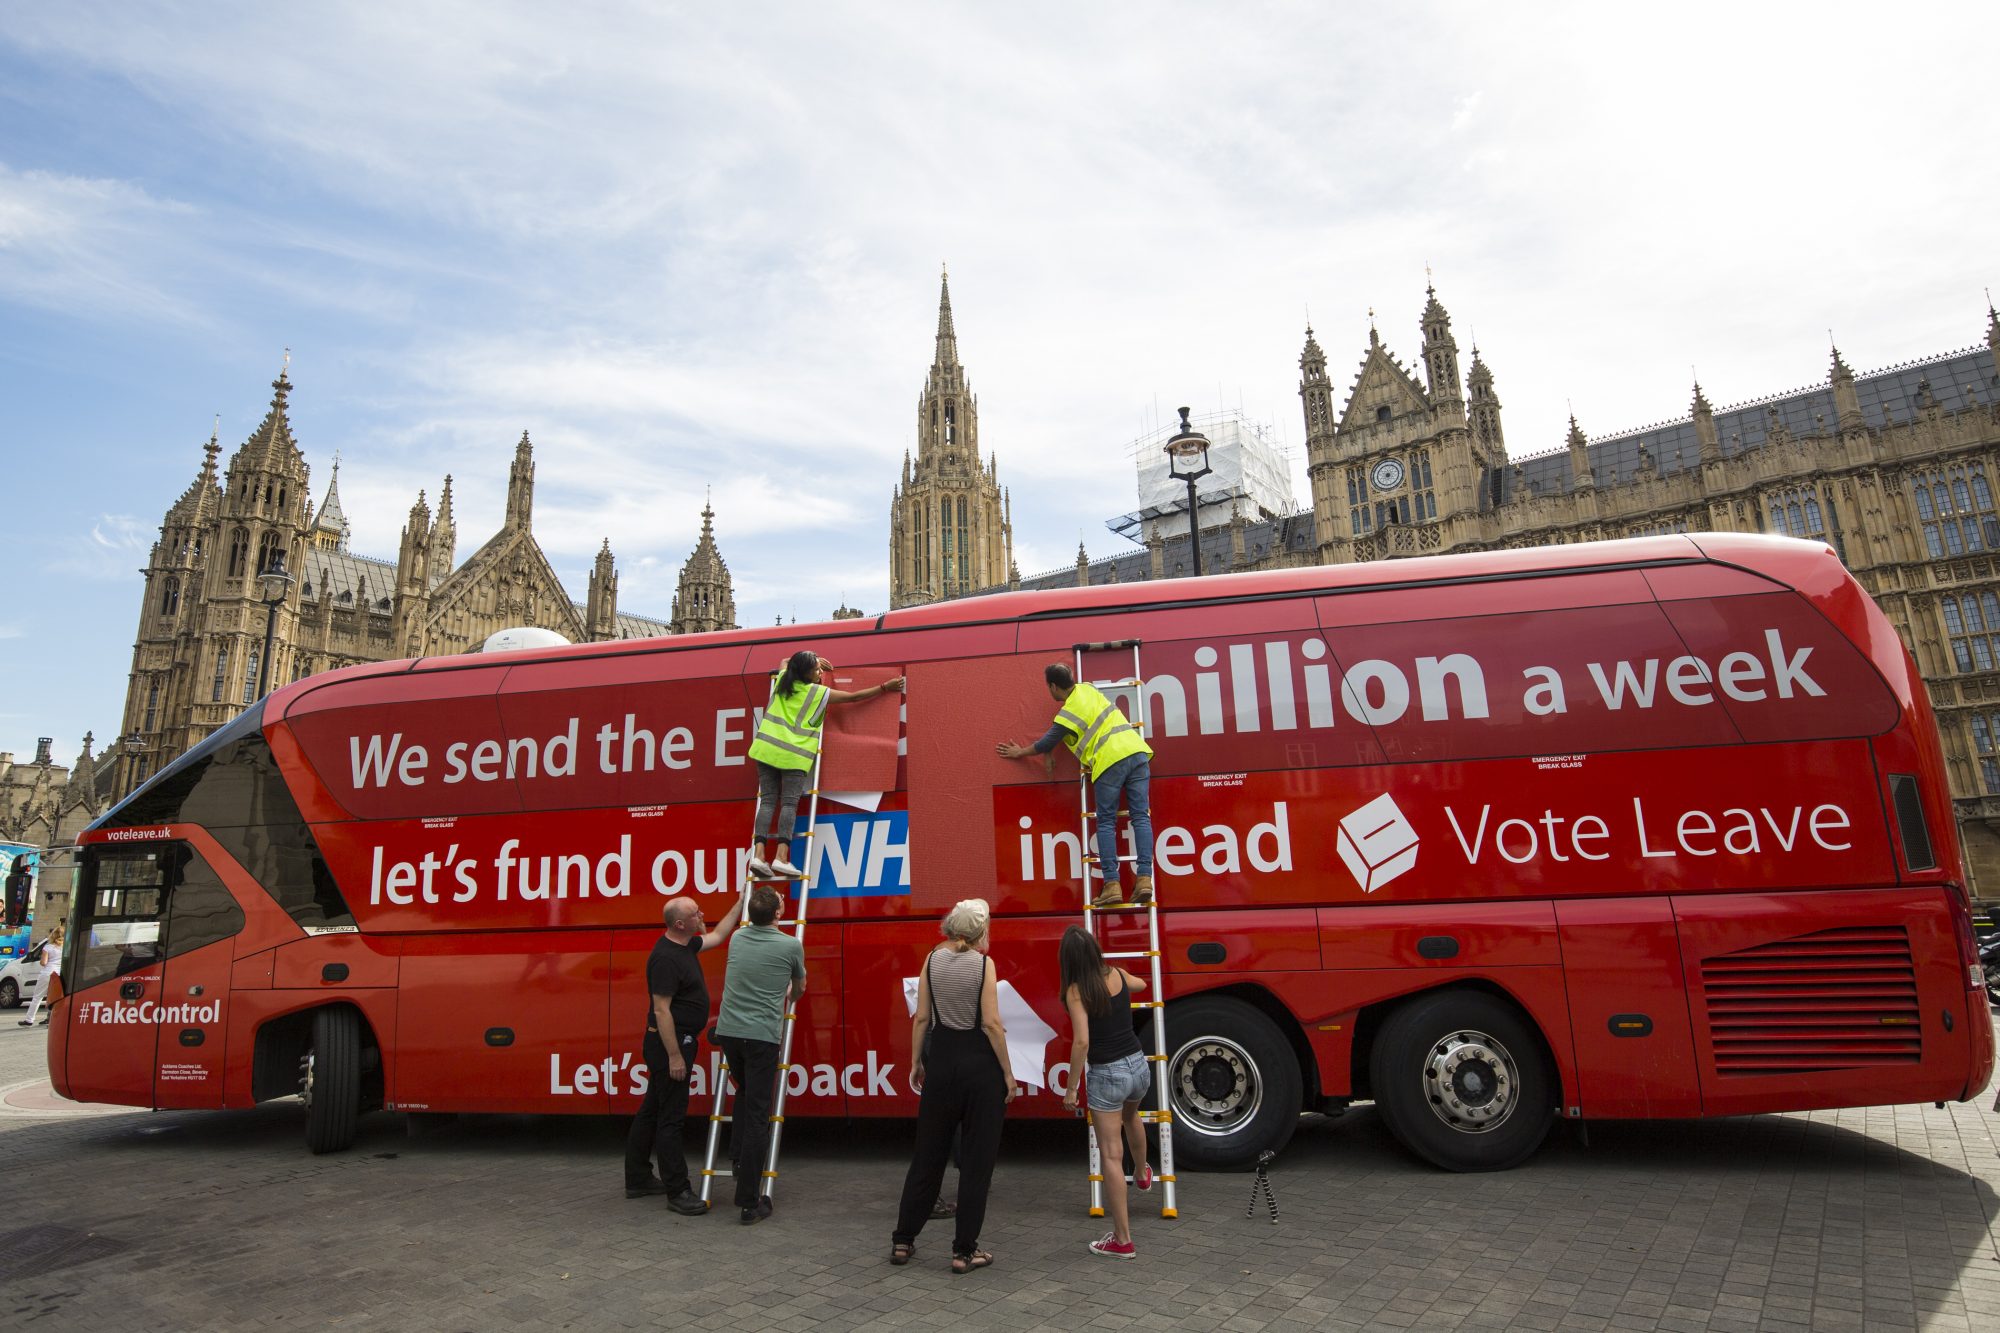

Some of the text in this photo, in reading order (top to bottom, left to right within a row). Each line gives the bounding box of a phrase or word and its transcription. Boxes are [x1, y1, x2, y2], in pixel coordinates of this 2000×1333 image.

[350, 734, 428, 789] We
[444, 718, 578, 783] send
[597, 714, 694, 774] the
[1093, 638, 1489, 739] million
[1523, 665, 1568, 716] a
[1587, 629, 1828, 711] week
[1560, 761, 1583, 769] GLASS
[107, 826, 171, 841] voteleave.uk
[1444, 797, 1852, 865] Vote Leave
[370, 846, 478, 905] let's
[495, 834, 631, 901] fund
[79, 999, 221, 1025] #TakeControl
[550, 1052, 649, 1096] Let's
